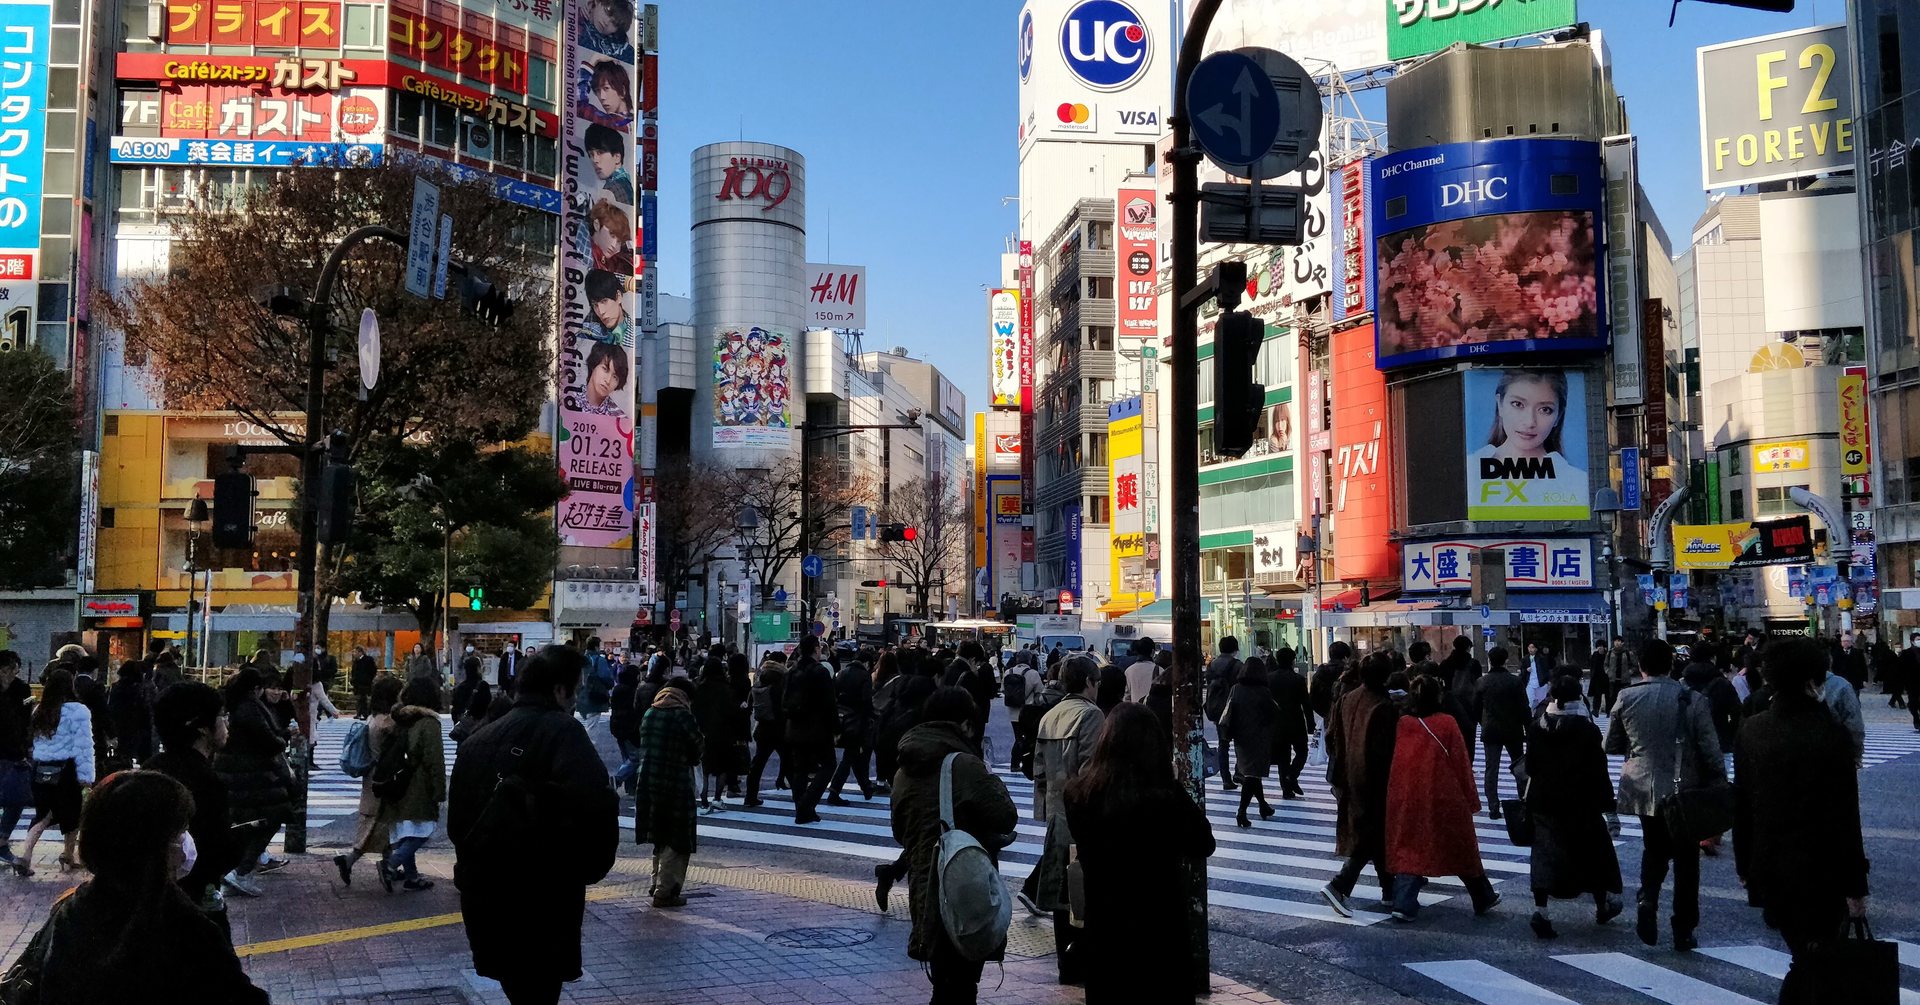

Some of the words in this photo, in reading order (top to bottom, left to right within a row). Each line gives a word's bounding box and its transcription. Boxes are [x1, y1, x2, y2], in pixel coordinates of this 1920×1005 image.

[169, 3, 335, 36] プライス
[567, 11, 576, 41] TRAIN
[389, 15, 523, 80] コンタクト
[1068, 19, 1142, 65] UC
[272, 57, 355, 90] ガスト
[567, 45, 576, 78] ARENA
[169, 99, 214, 119] Café
[566, 81, 575, 108] TOUR
[121, 99, 160, 124] 7F
[169, 120, 214, 131] レストラン
[219, 96, 322, 136] ガスト
[342, 113, 375, 125] ガスト
[487, 97, 547, 135] ガスト
[566, 113, 574, 137] 2018
[1116, 110, 1158, 126] VISA
[0, 26, 35, 229] コンタクトの
[119, 142, 170, 158] AEON
[730, 157, 790, 172] SHIBUYA
[1381, 163, 1402, 179] DHC
[1403, 154, 1445, 172] Channel
[565, 140, 585, 260] Sweetest
[715, 166, 793, 212] 109
[1441, 176, 1508, 208] DHC
[1343, 166, 1360, 309] 三千里薬品
[810, 272, 859, 306] H&M
[1128, 296, 1153, 311] B2F
[564, 267, 584, 412] Battlefield
[1469, 344, 1490, 354] DHC
[571, 434, 622, 459] 01.23
[1846, 453, 1861, 463] 4F
[570, 459, 622, 477] RELEASE
[976, 459, 984, 500] Matsumoto
[1337, 419, 1382, 513] クスリ
[1480, 457, 1556, 480] DMM
[573, 480, 590, 488] LIVE
[592, 482, 619, 492] Blu-ray
[1117, 473, 1138, 512] 薬
[1480, 481, 1530, 503] FX
[1543, 492, 1578, 503] ROLA
[1411, 546, 1582, 581] 大盛書店
